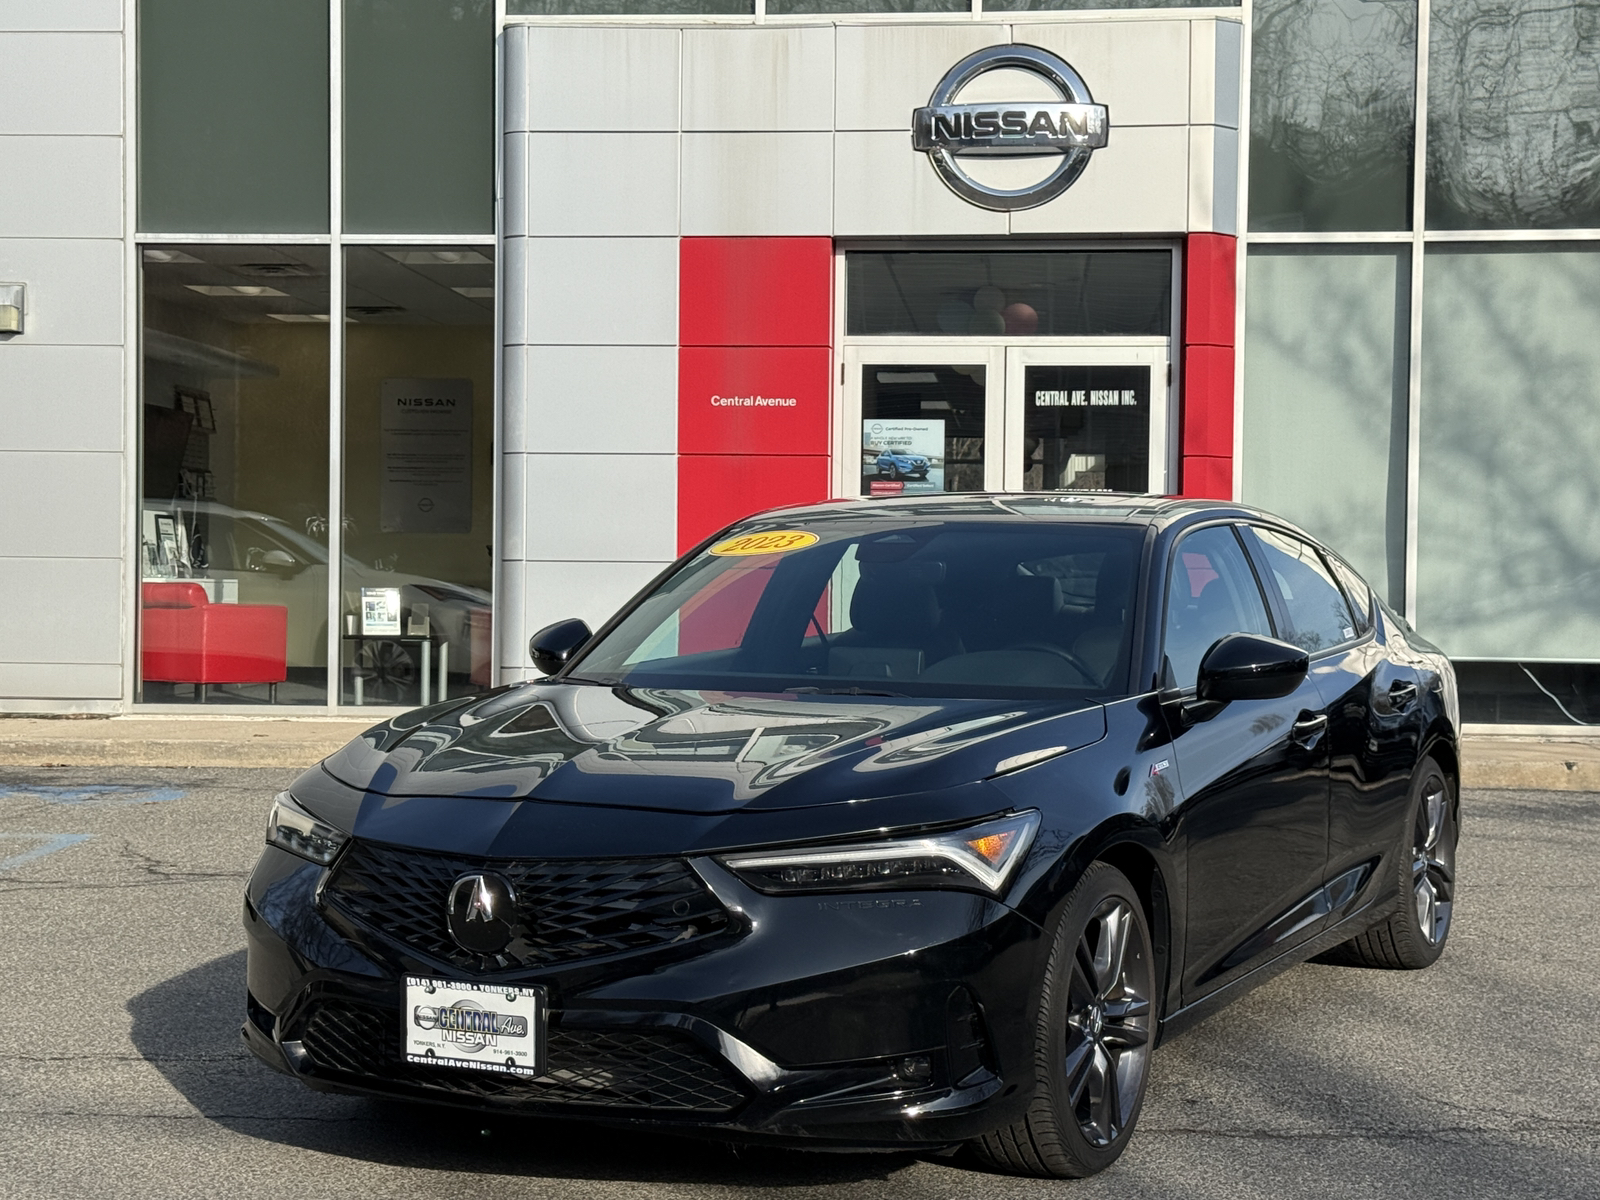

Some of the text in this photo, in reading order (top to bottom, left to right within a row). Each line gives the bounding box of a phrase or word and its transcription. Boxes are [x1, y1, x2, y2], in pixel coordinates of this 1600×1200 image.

[932, 110, 1089, 141] NISSAN
[397, 398, 456, 407] NISSAN
[710, 395, 797, 406] Central Avenue
[1035, 390, 1137, 406] CENTRAL AVE. NISSAN INC.
[720, 534, 805, 552] 2023
[817, 898, 925, 911] INTEGRA
[438, 1006, 525, 1035] CENTRAL Ave.
[441, 1030, 497, 1047] NISSAN
[407, 1055, 534, 1076] CentralAveNissan.com
